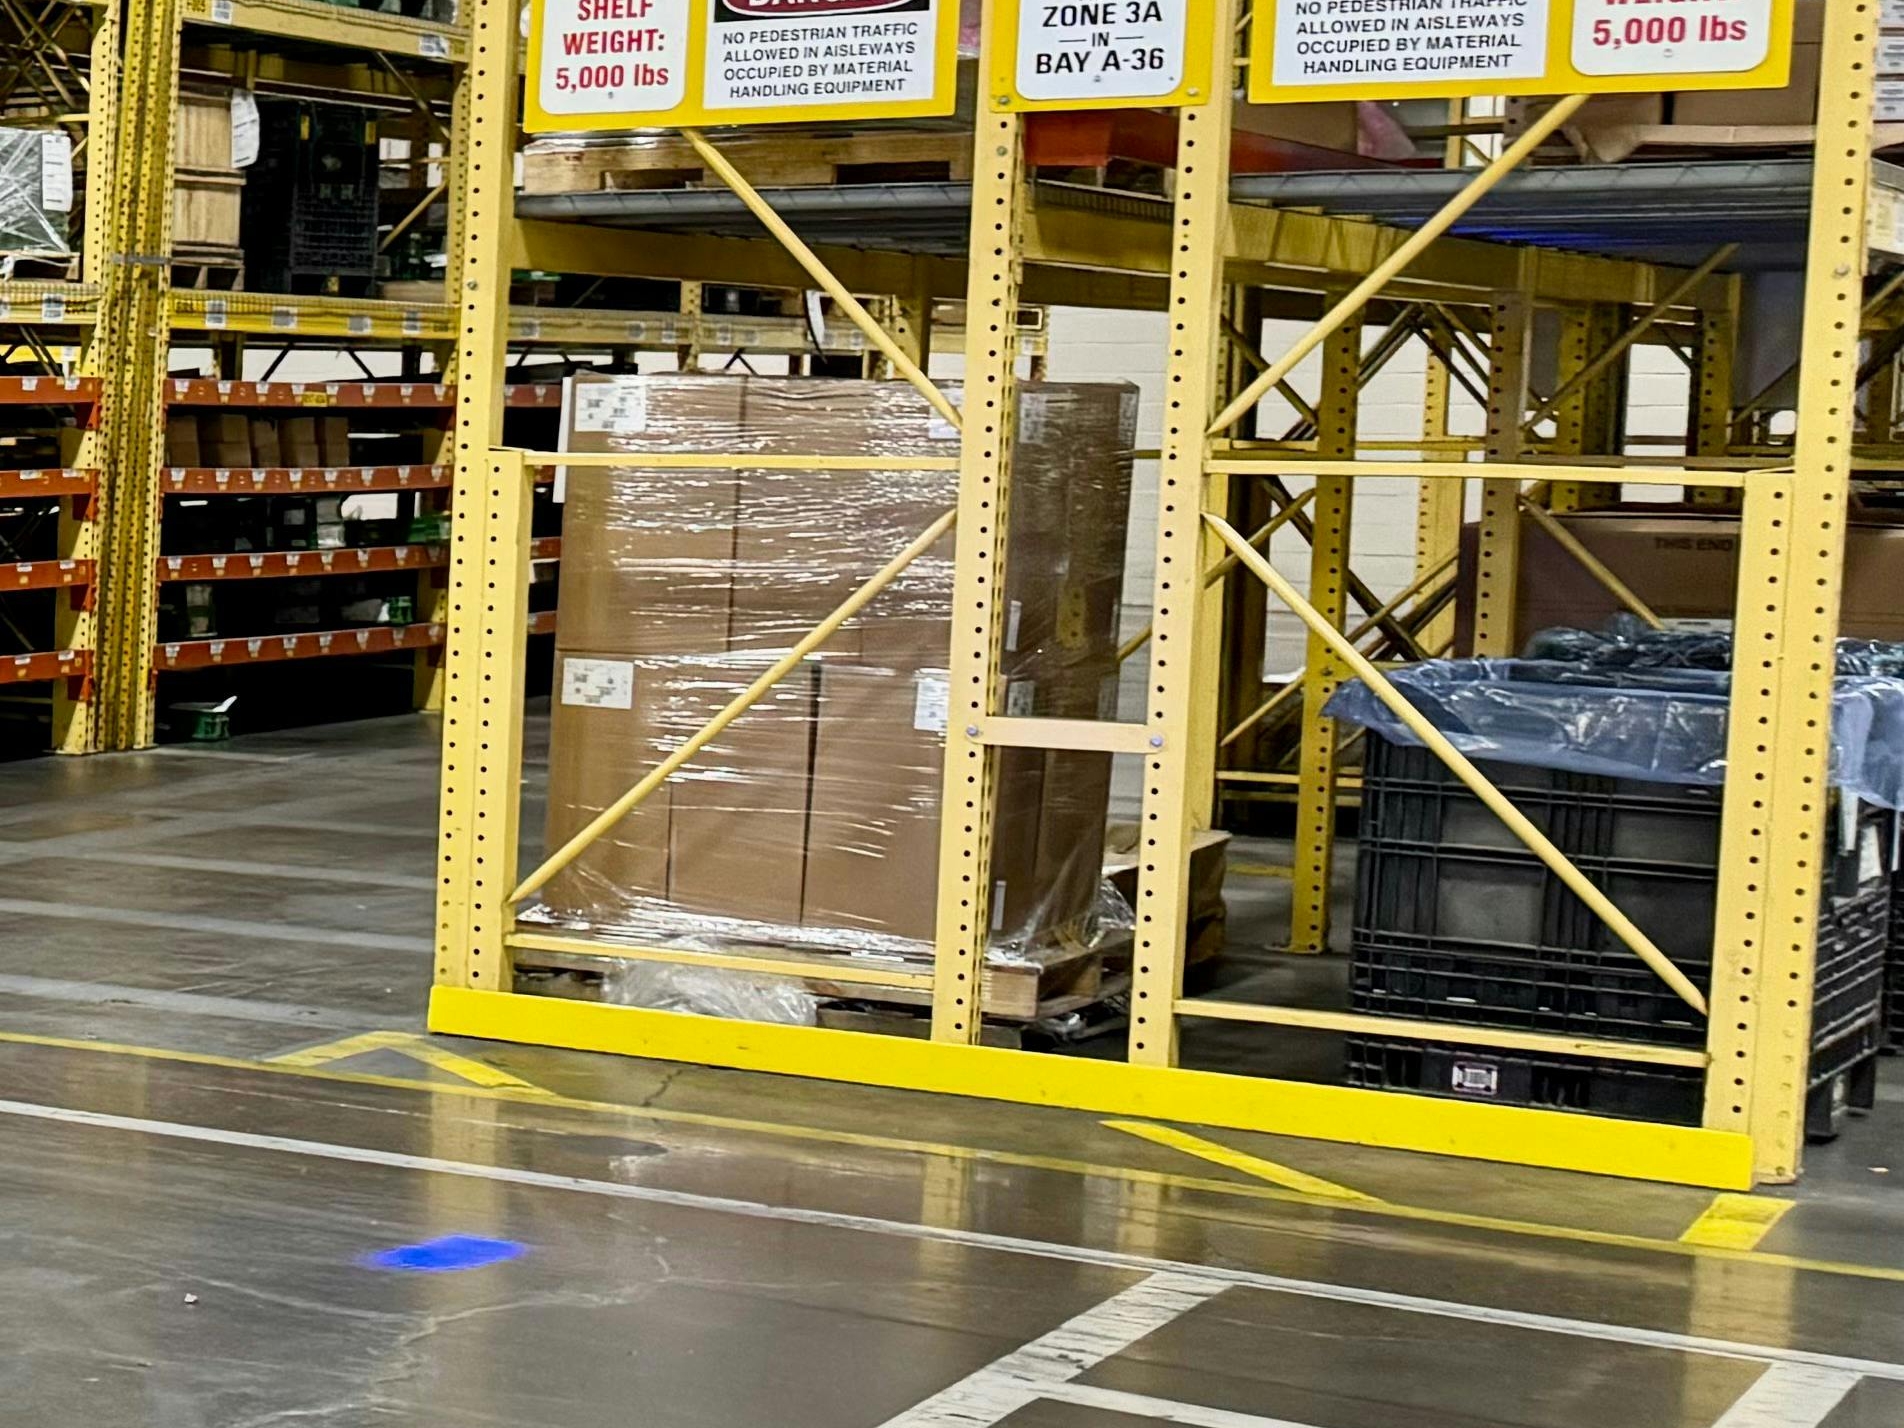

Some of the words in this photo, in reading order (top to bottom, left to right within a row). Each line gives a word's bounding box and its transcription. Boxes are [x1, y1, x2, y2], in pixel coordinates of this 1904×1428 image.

[1042, 2, 1117, 28] ZONE
[1125, 0, 1163, 23] 3A
[1295, 2, 1321, 15] NO
[722, 32, 745, 45] NO
[749, 26, 847, 44] PEDESTRIAN
[852, 22, 918, 37] TRAFFIC
[1296, 18, 1386, 35] ALLOWED
[1392, 18, 1409, 31] IN
[1414, 12, 1525, 30] AISLEWAYS
[1593, 16, 1686, 50] 5,000
[1698, 15, 1747, 42] lbs
[563, 28, 665, 56] WEIGHT:
[1092, 32, 1110, 47] IN
[1297, 38, 1390, 55] OCCUPIED
[1396, 37, 1421, 52] BY
[1426, 34, 1522, 50] MATERIAL
[723, 47, 799, 62] ALLOWED
[803, 46, 818, 59] IN
[823, 41, 916, 58] AISLEWAYS
[1035, 51, 1091, 75] BAY
[1101, 47, 1165, 72] A-36
[724, 65, 803, 81] OCCUPIED
[808, 63, 828, 77] BY
[833, 60, 913, 76] MATERIAL
[1304, 58, 1397, 75] HANDLING
[1402, 54, 1513, 72] EQUIPMENT
[556, 65, 624, 94] 5,000
[634, 63, 669, 87] lbs
[730, 82, 809, 98] HANDLING
[814, 78, 906, 95] EQUIPMENT
